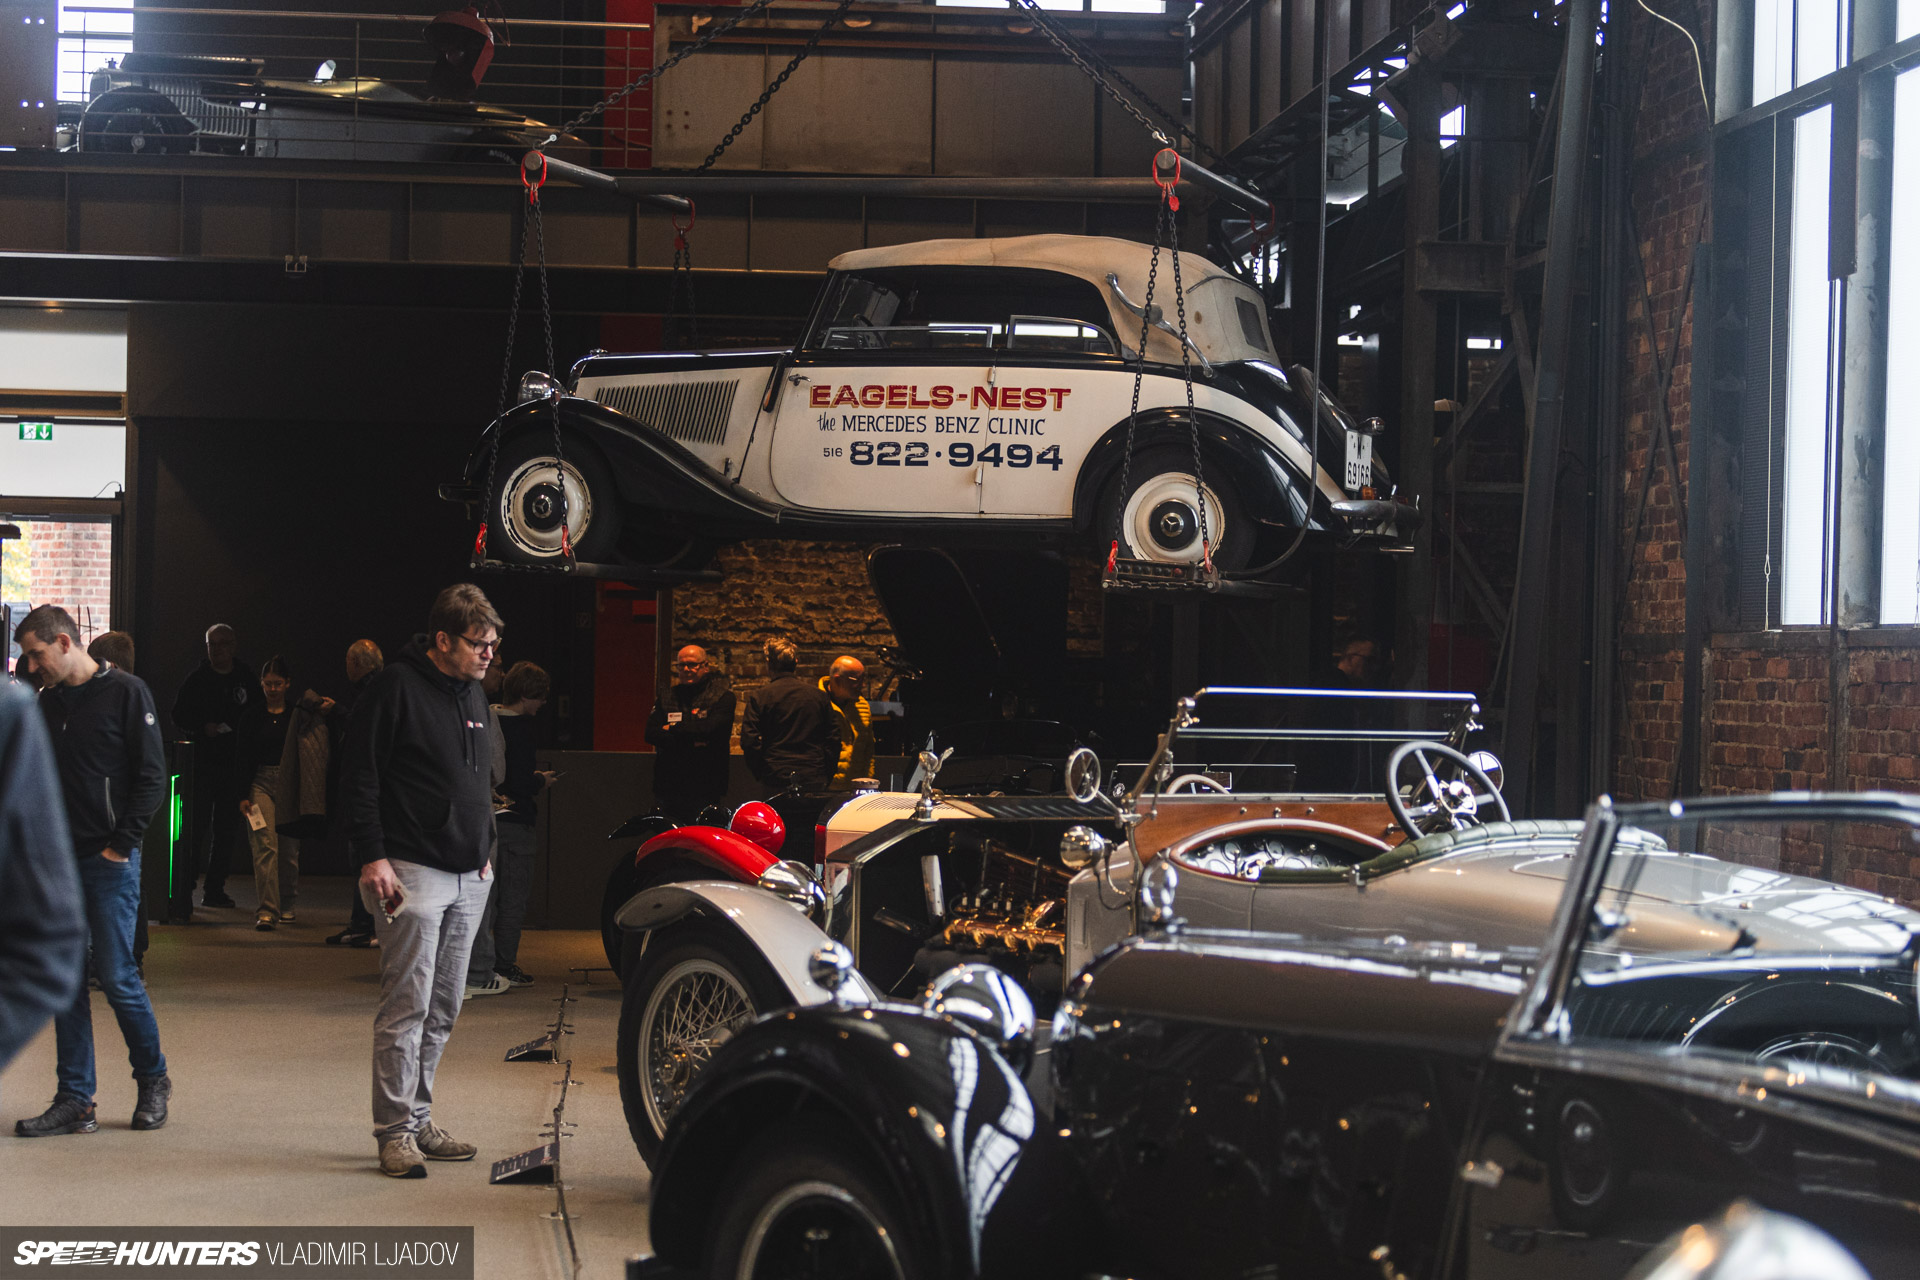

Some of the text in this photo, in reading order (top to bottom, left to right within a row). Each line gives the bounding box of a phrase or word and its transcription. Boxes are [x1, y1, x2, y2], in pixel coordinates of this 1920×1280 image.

[809, 384, 1072, 412] EAGELS-NEST
[816, 411, 1046, 436] the MERCEDES BENZ CLINIC
[823, 447, 843, 458] 516
[1347, 461, 1370, 487] 69166
